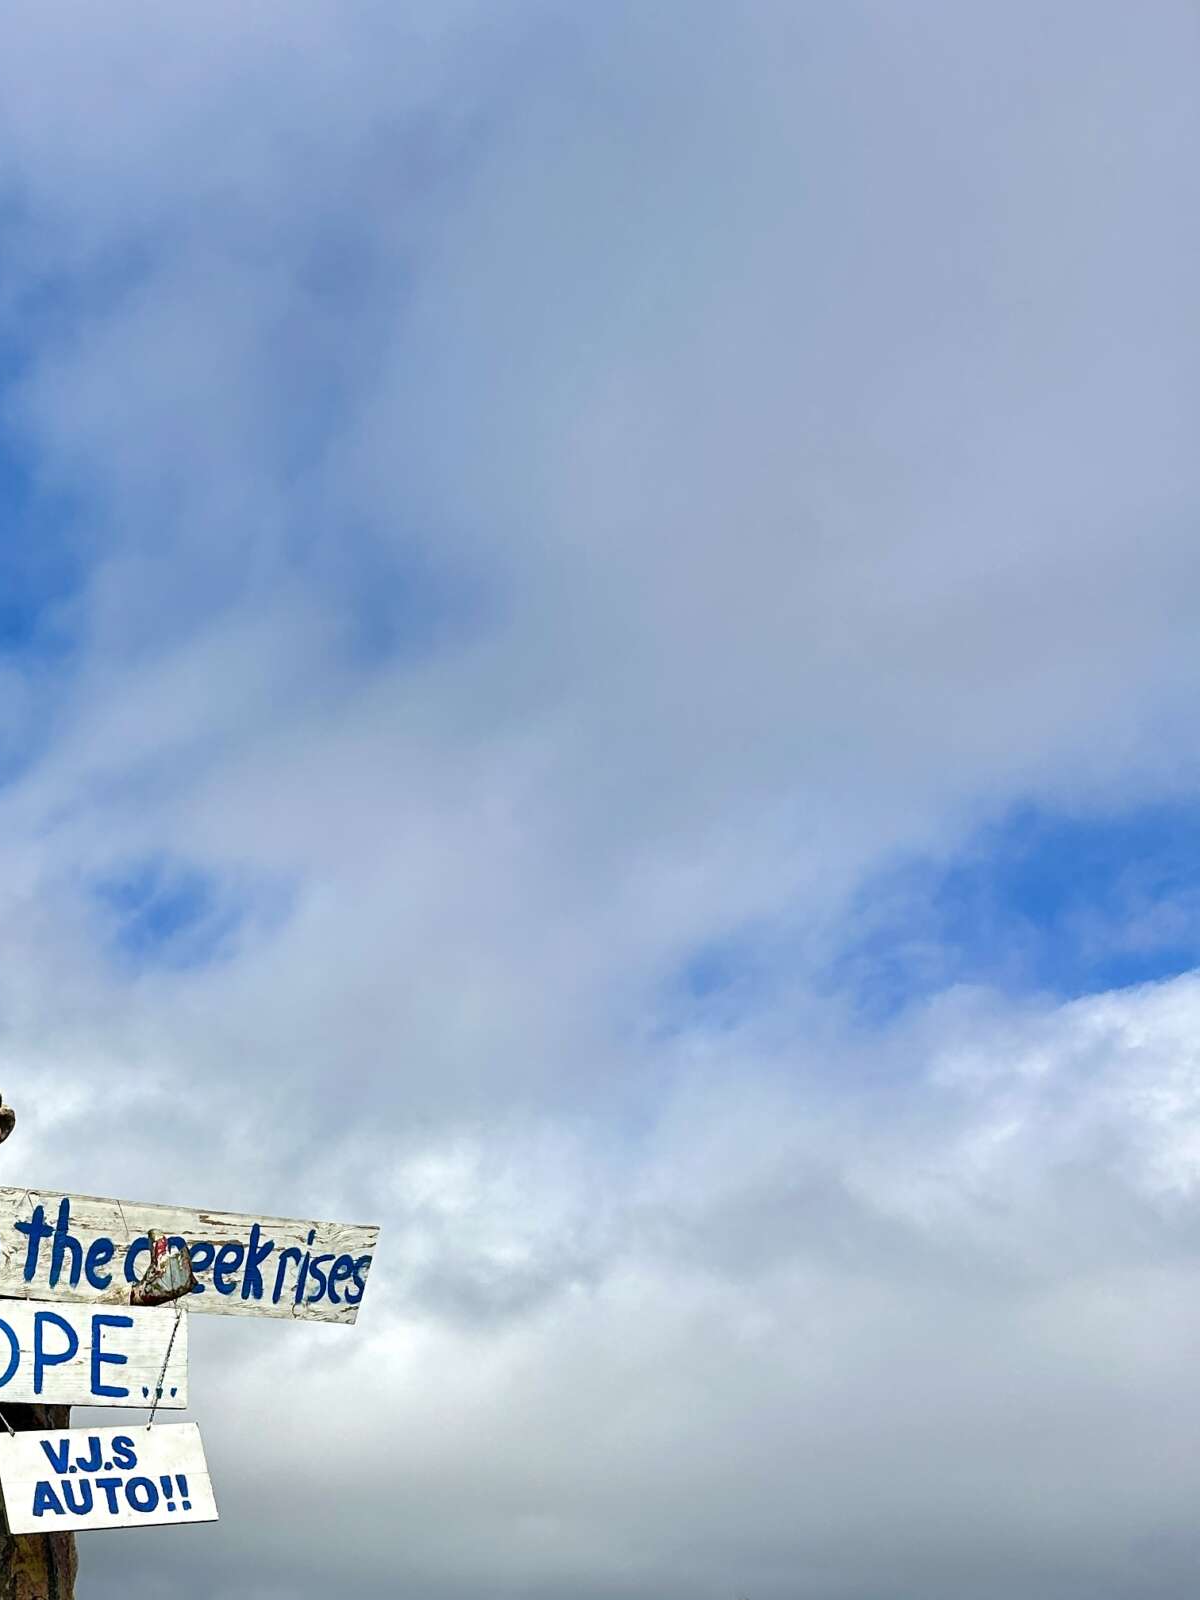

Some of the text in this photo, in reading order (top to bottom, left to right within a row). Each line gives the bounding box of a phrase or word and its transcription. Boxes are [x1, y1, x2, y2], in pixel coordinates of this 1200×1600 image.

[15, 1197, 115, 1291] the
[272, 1229, 373, 1305] rises
[40, 1435, 138, 1475] V.J.S
[32, 1474, 192, 1518] AUTO!!
